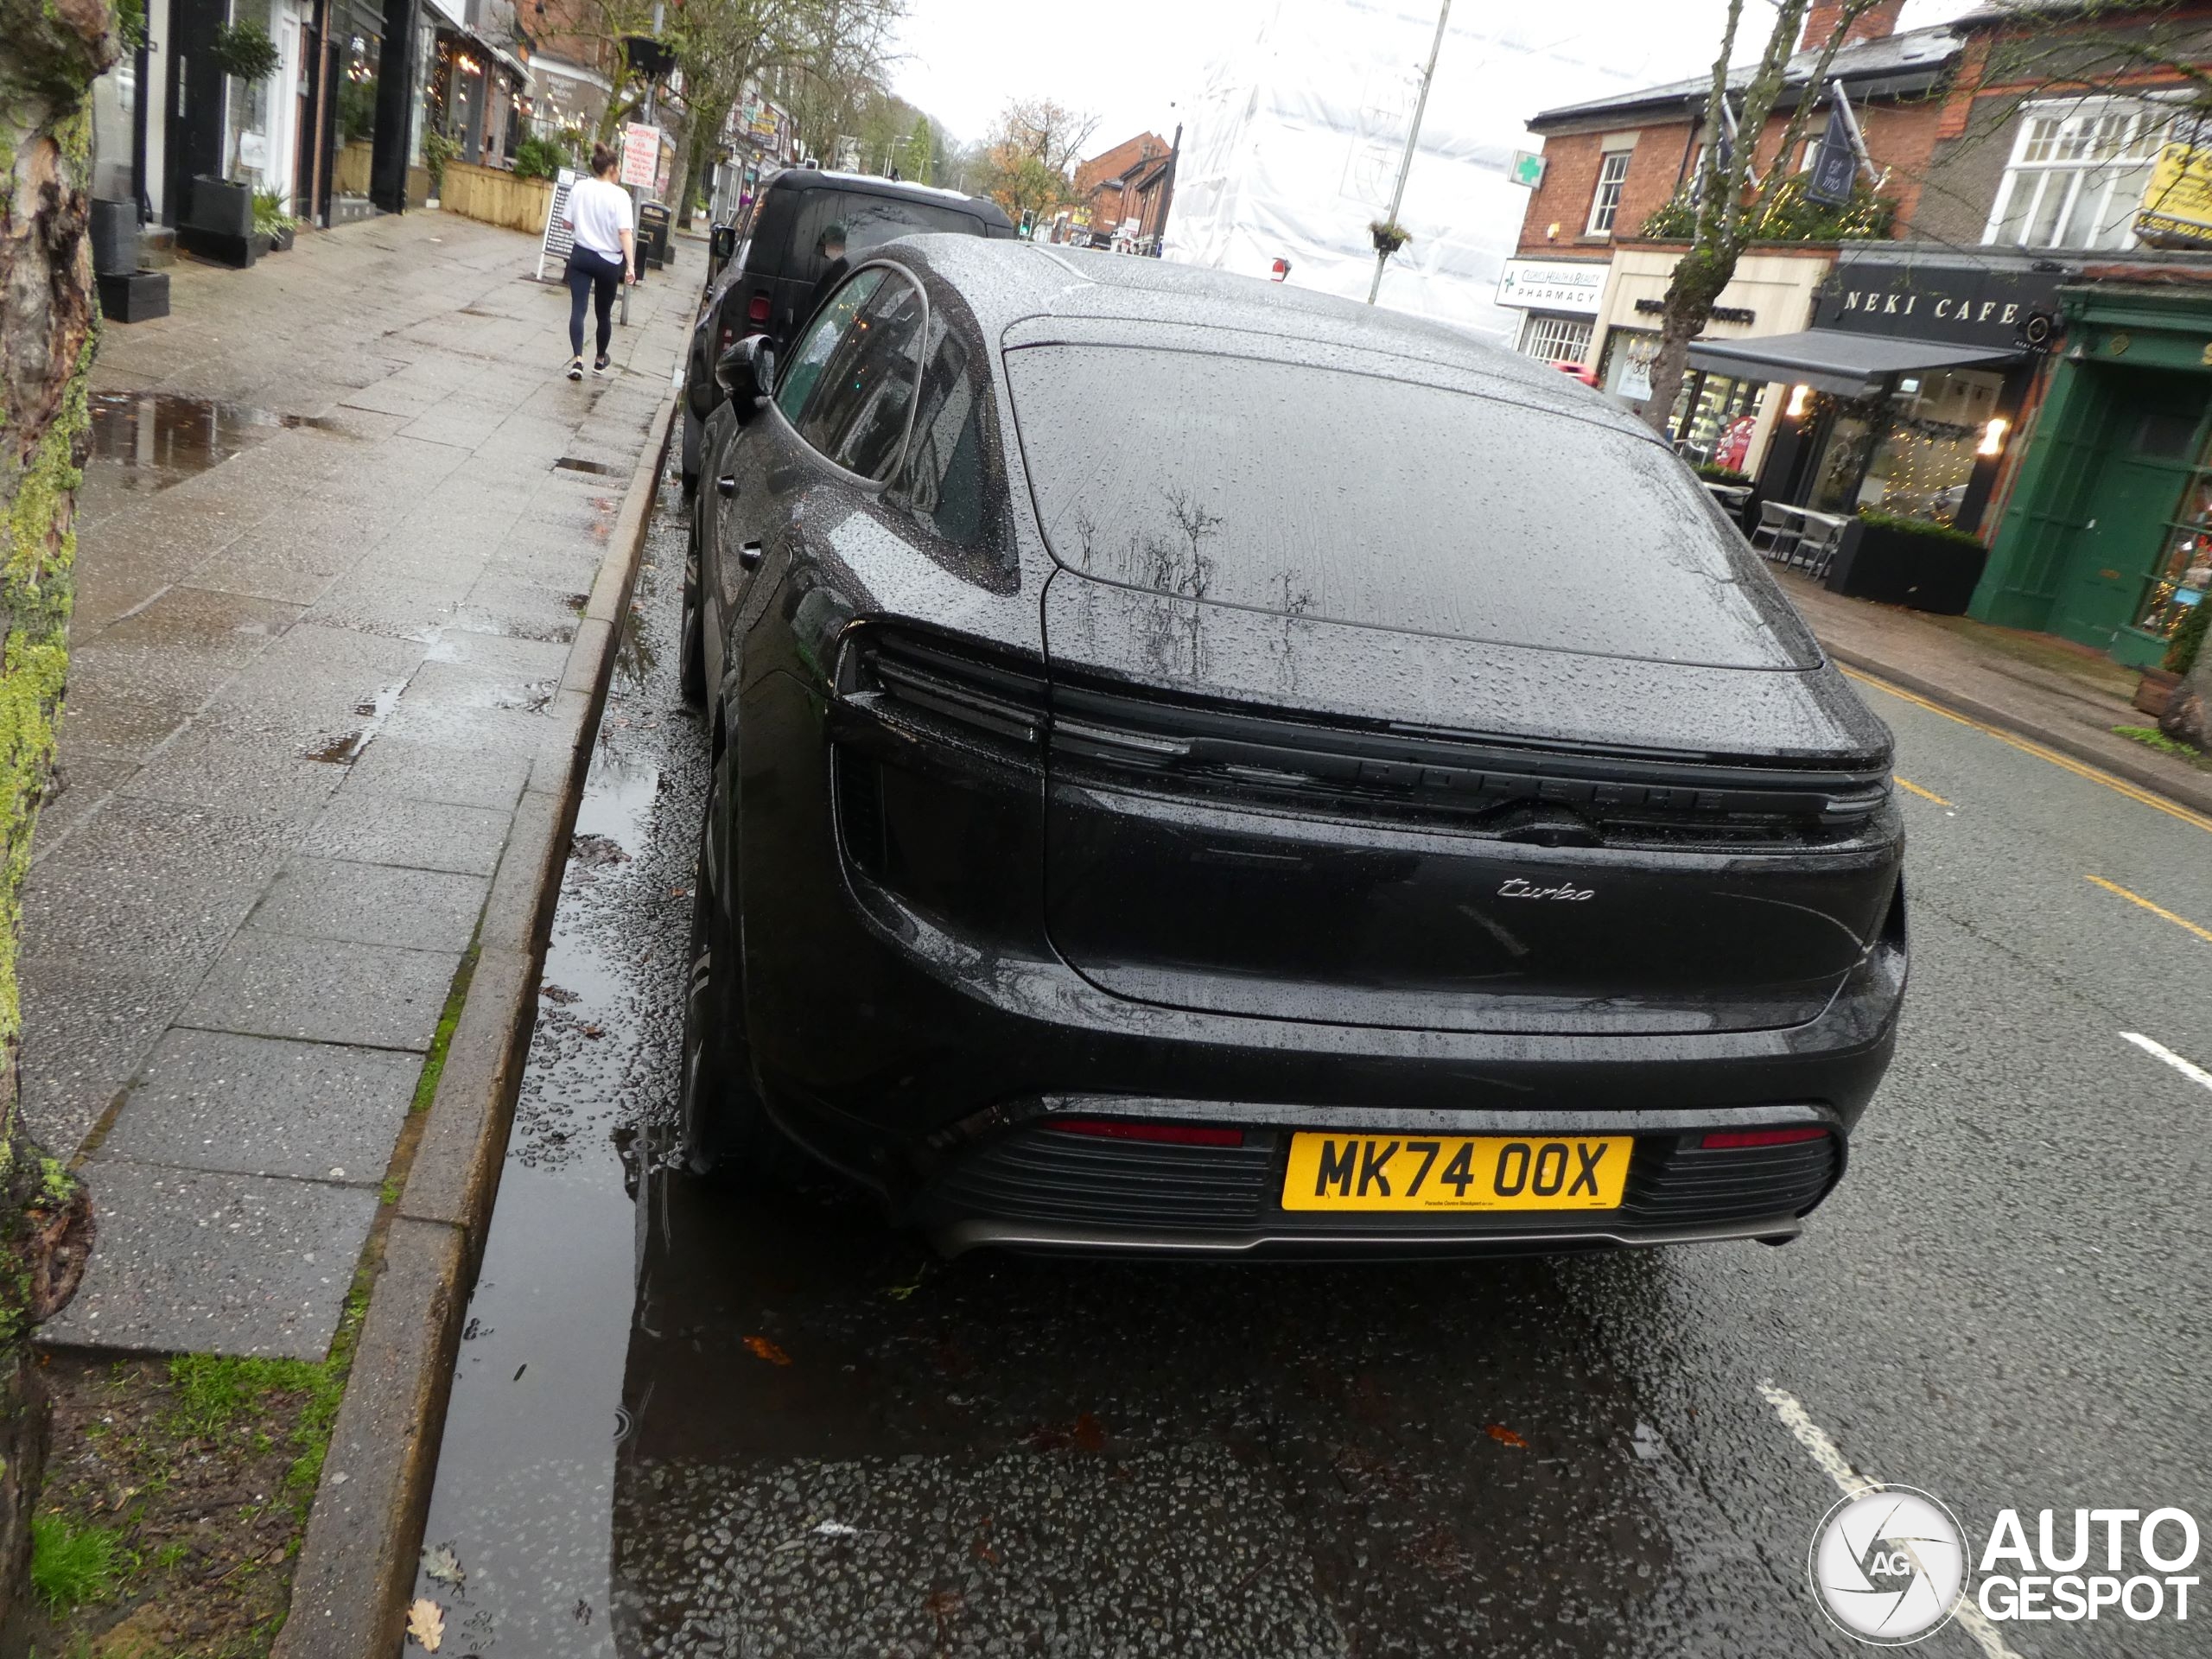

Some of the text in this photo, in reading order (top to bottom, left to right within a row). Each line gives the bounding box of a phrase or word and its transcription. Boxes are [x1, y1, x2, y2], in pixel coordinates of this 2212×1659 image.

[1518, 288, 1595, 302] PHARMACY
[1844, 291, 2019, 325] NEKI CAFE
[1497, 878, 1595, 900] turbo
[1314, 1141, 1475, 1198] MK74
